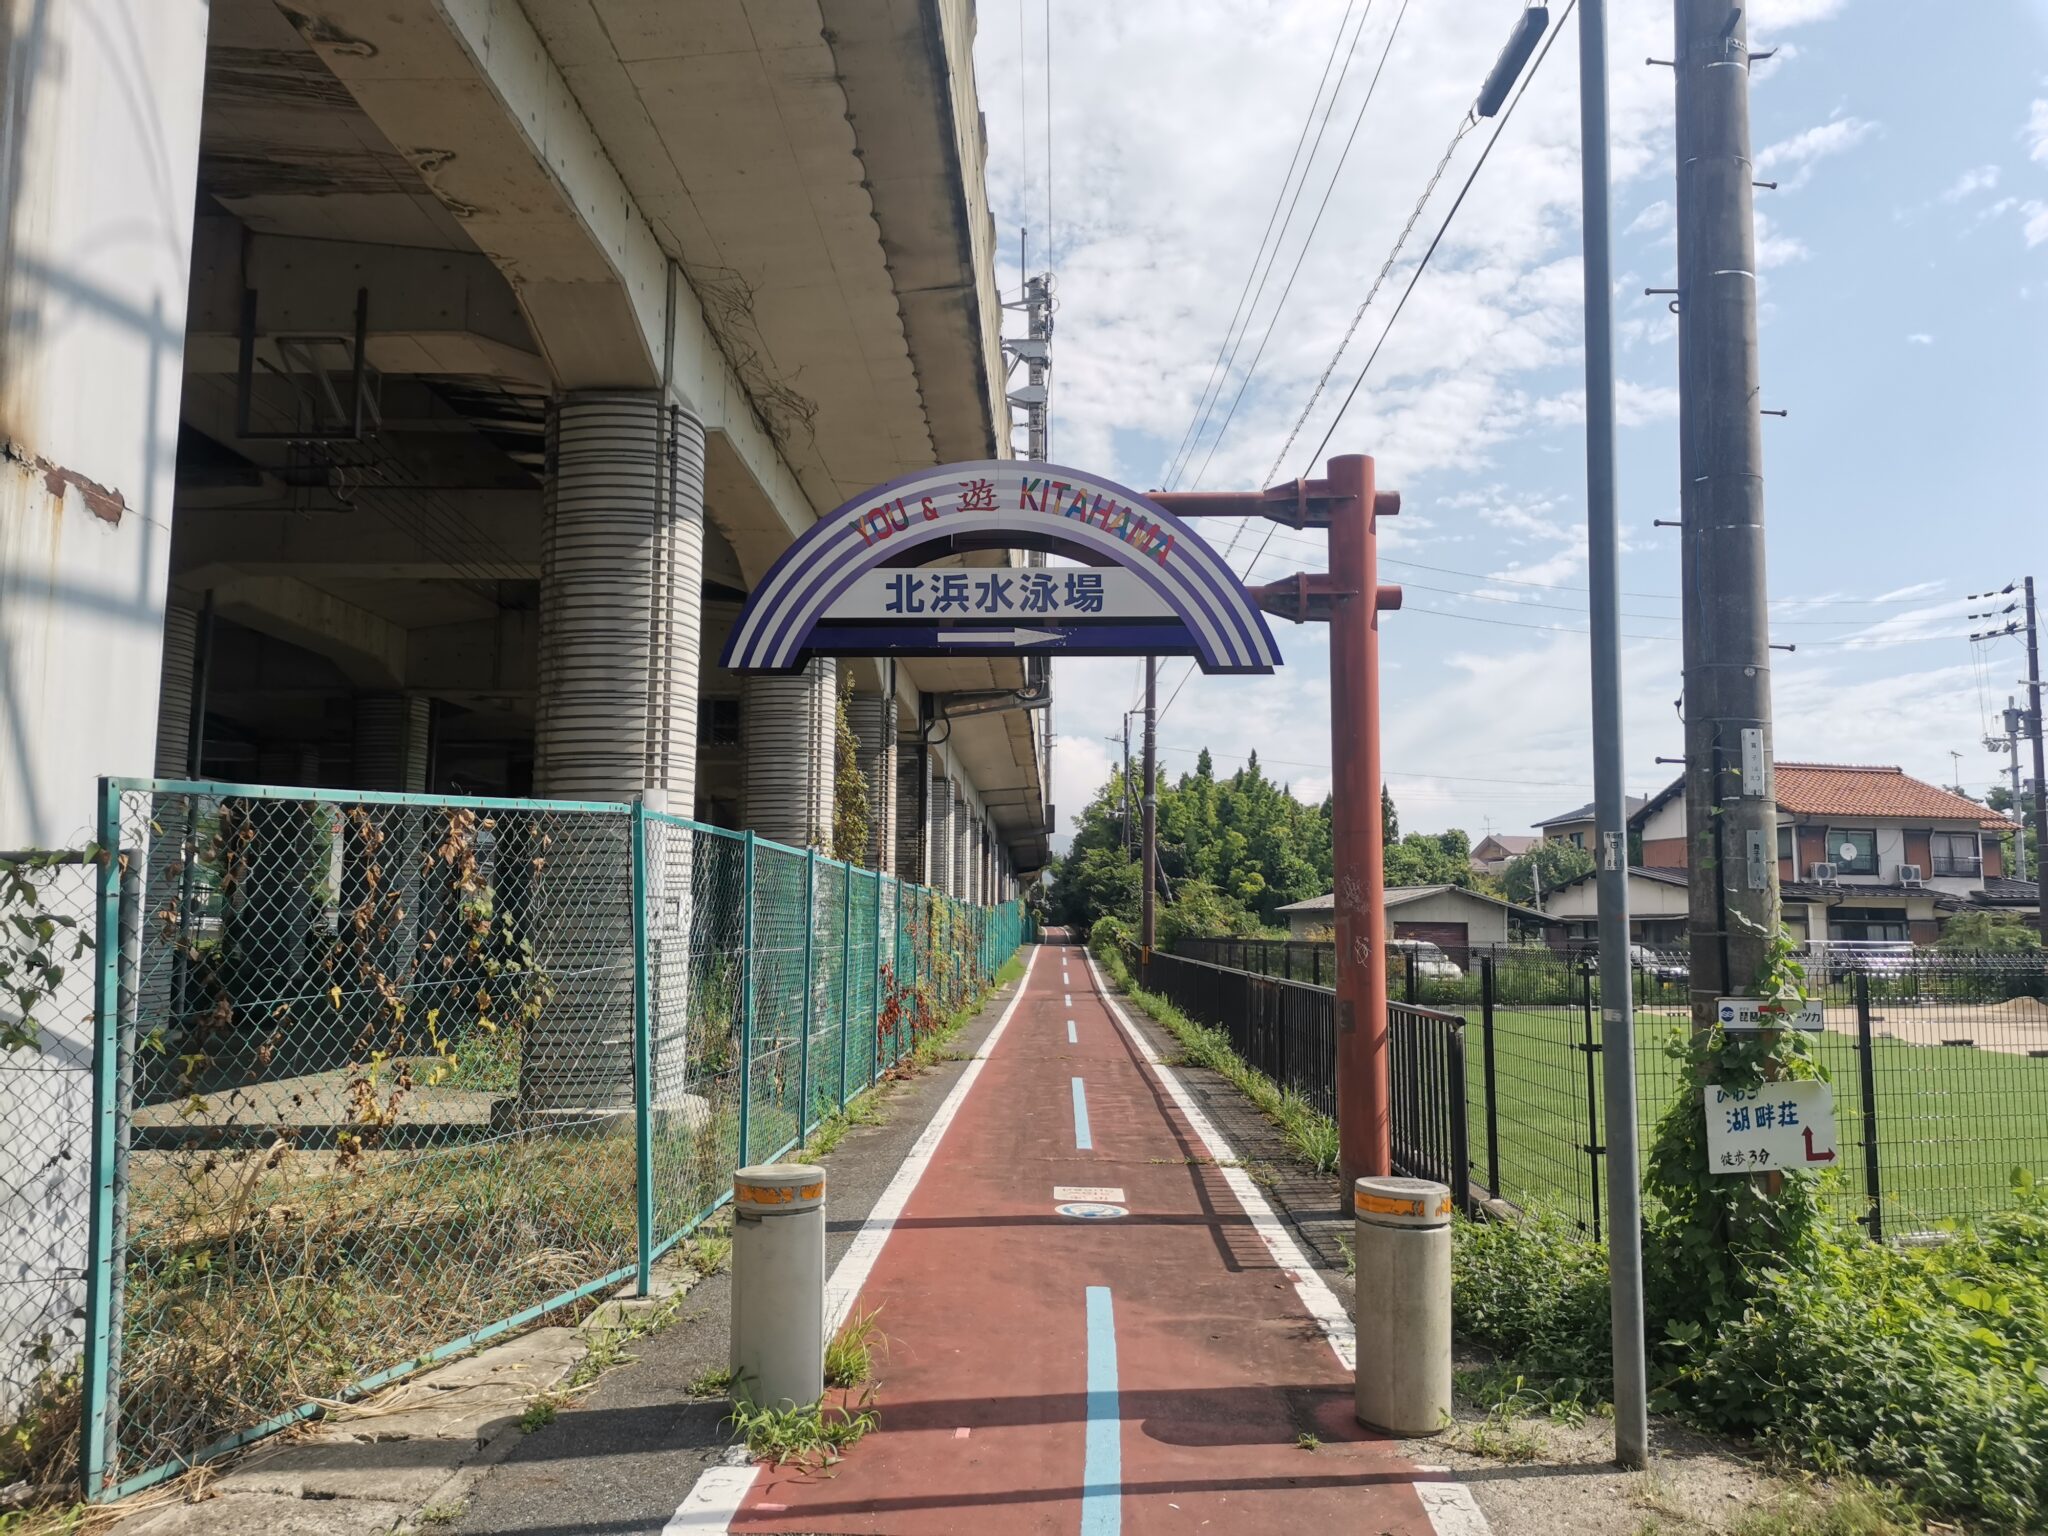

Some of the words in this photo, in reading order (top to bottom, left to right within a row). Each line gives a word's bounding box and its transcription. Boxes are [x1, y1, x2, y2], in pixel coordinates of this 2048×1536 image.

[849, 498, 910, 547] YOU
[921, 496, 940, 521] &
[956, 479, 1000, 512] 遊
[1019, 476, 1175, 566] KITAHAMA
[885, 573, 1105, 613] 北浜水泳場
[1727, 1100, 1799, 1134] 湖畔荘
